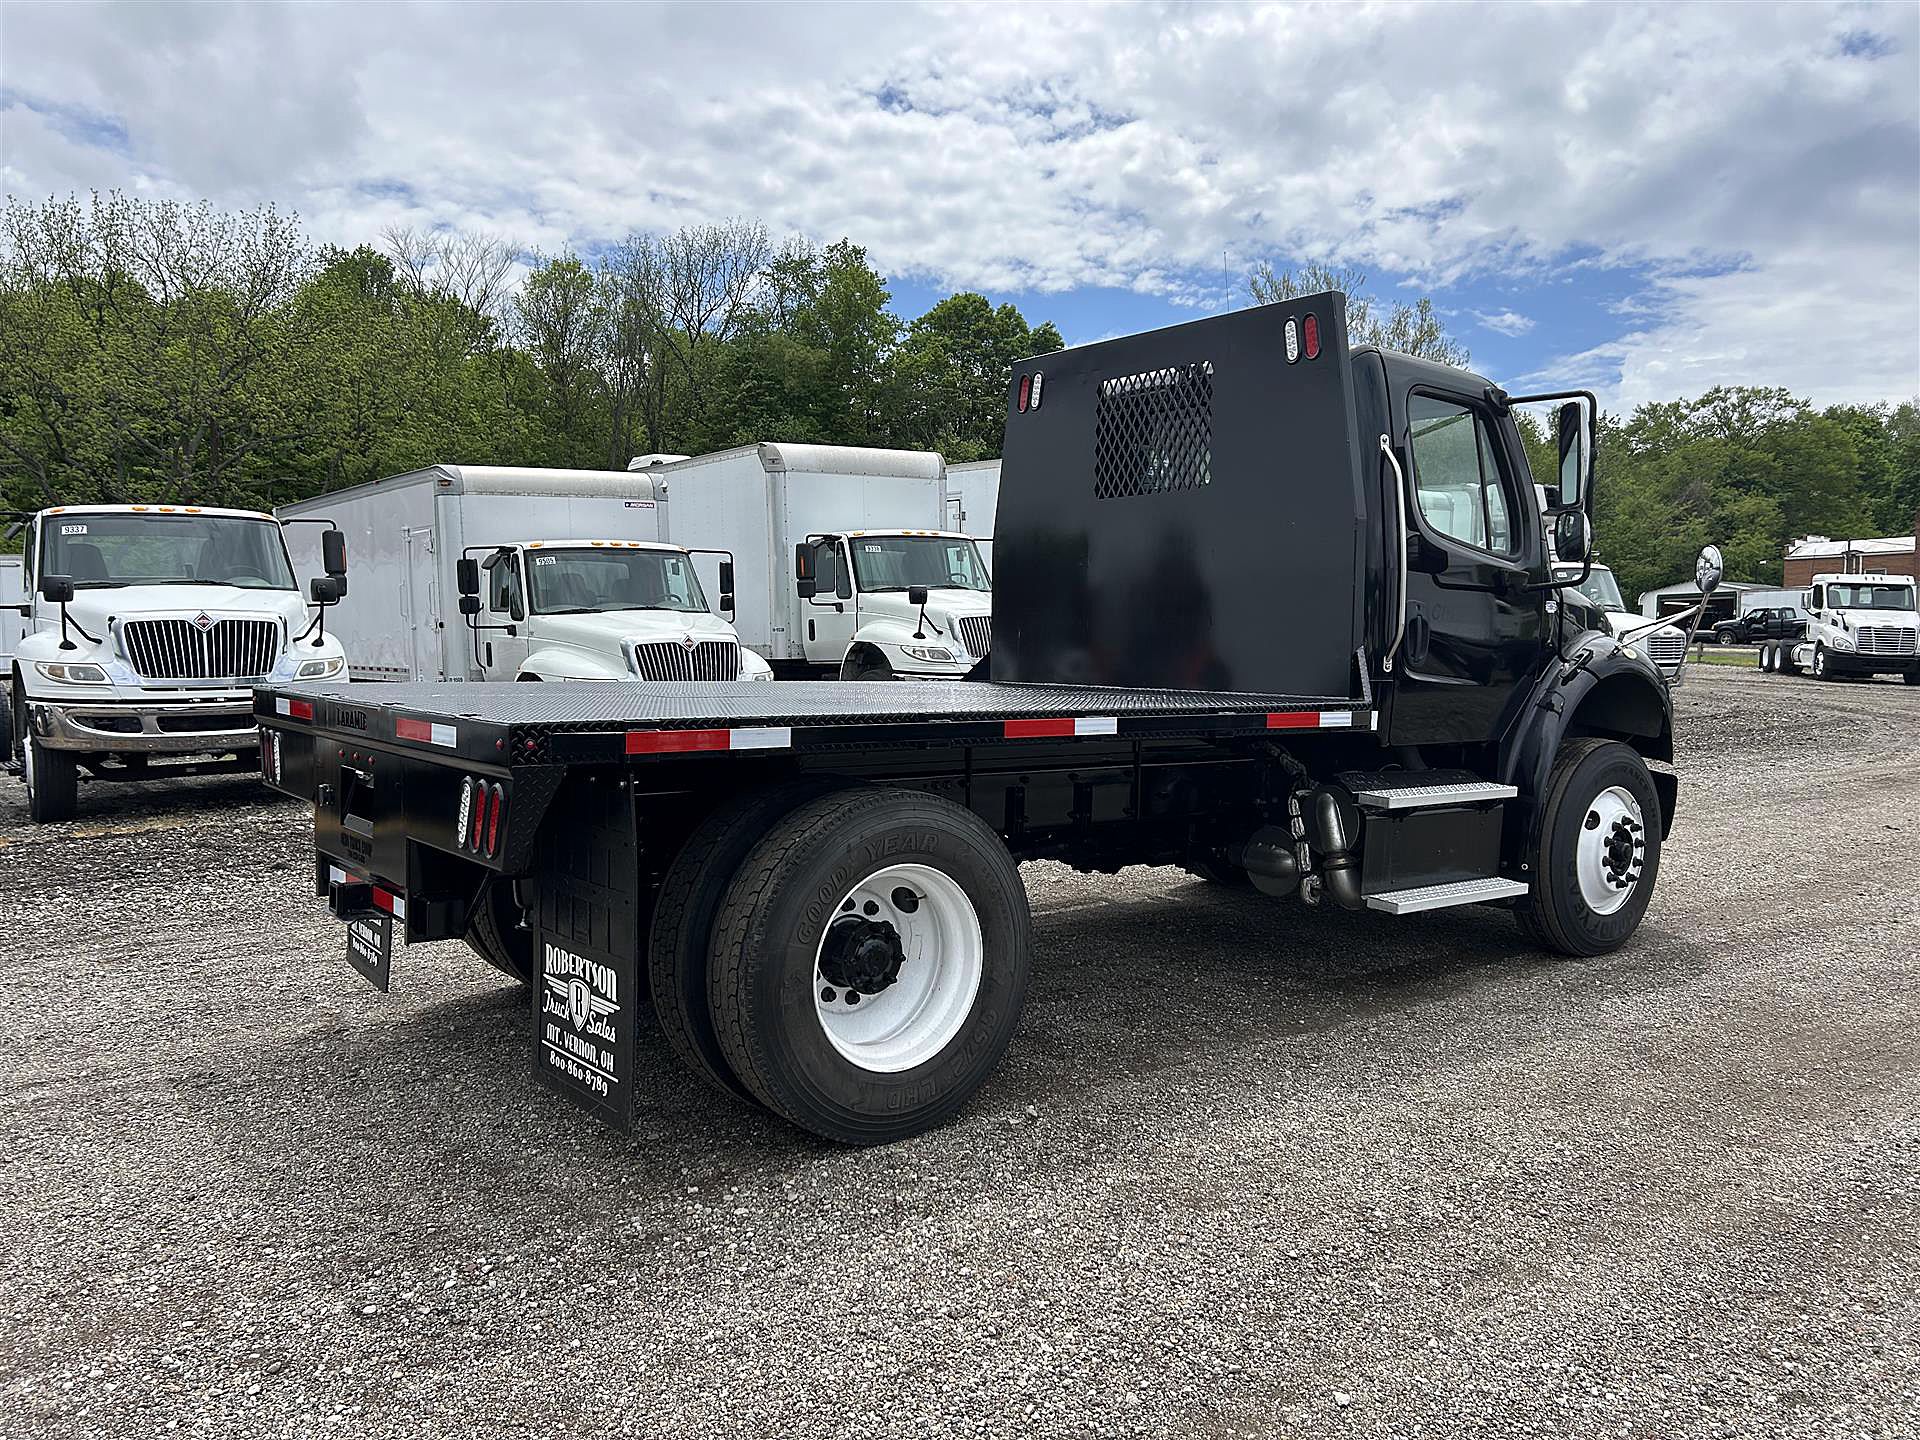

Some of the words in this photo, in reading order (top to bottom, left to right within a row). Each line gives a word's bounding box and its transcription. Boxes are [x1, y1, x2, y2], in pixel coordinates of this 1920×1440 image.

[64, 526, 84, 534] 9337
[337, 708, 367, 730] LARAMIE
[545, 943, 617, 1002] ROBERTSON
[542, 989, 570, 1021] Truck
[586, 1011, 616, 1043] Sales
[574, 984, 584, 1018] R
[546, 1022, 562, 1046] MT.
[564, 1031, 599, 1066] VERNON,
[600, 1050, 614, 1072] OH
